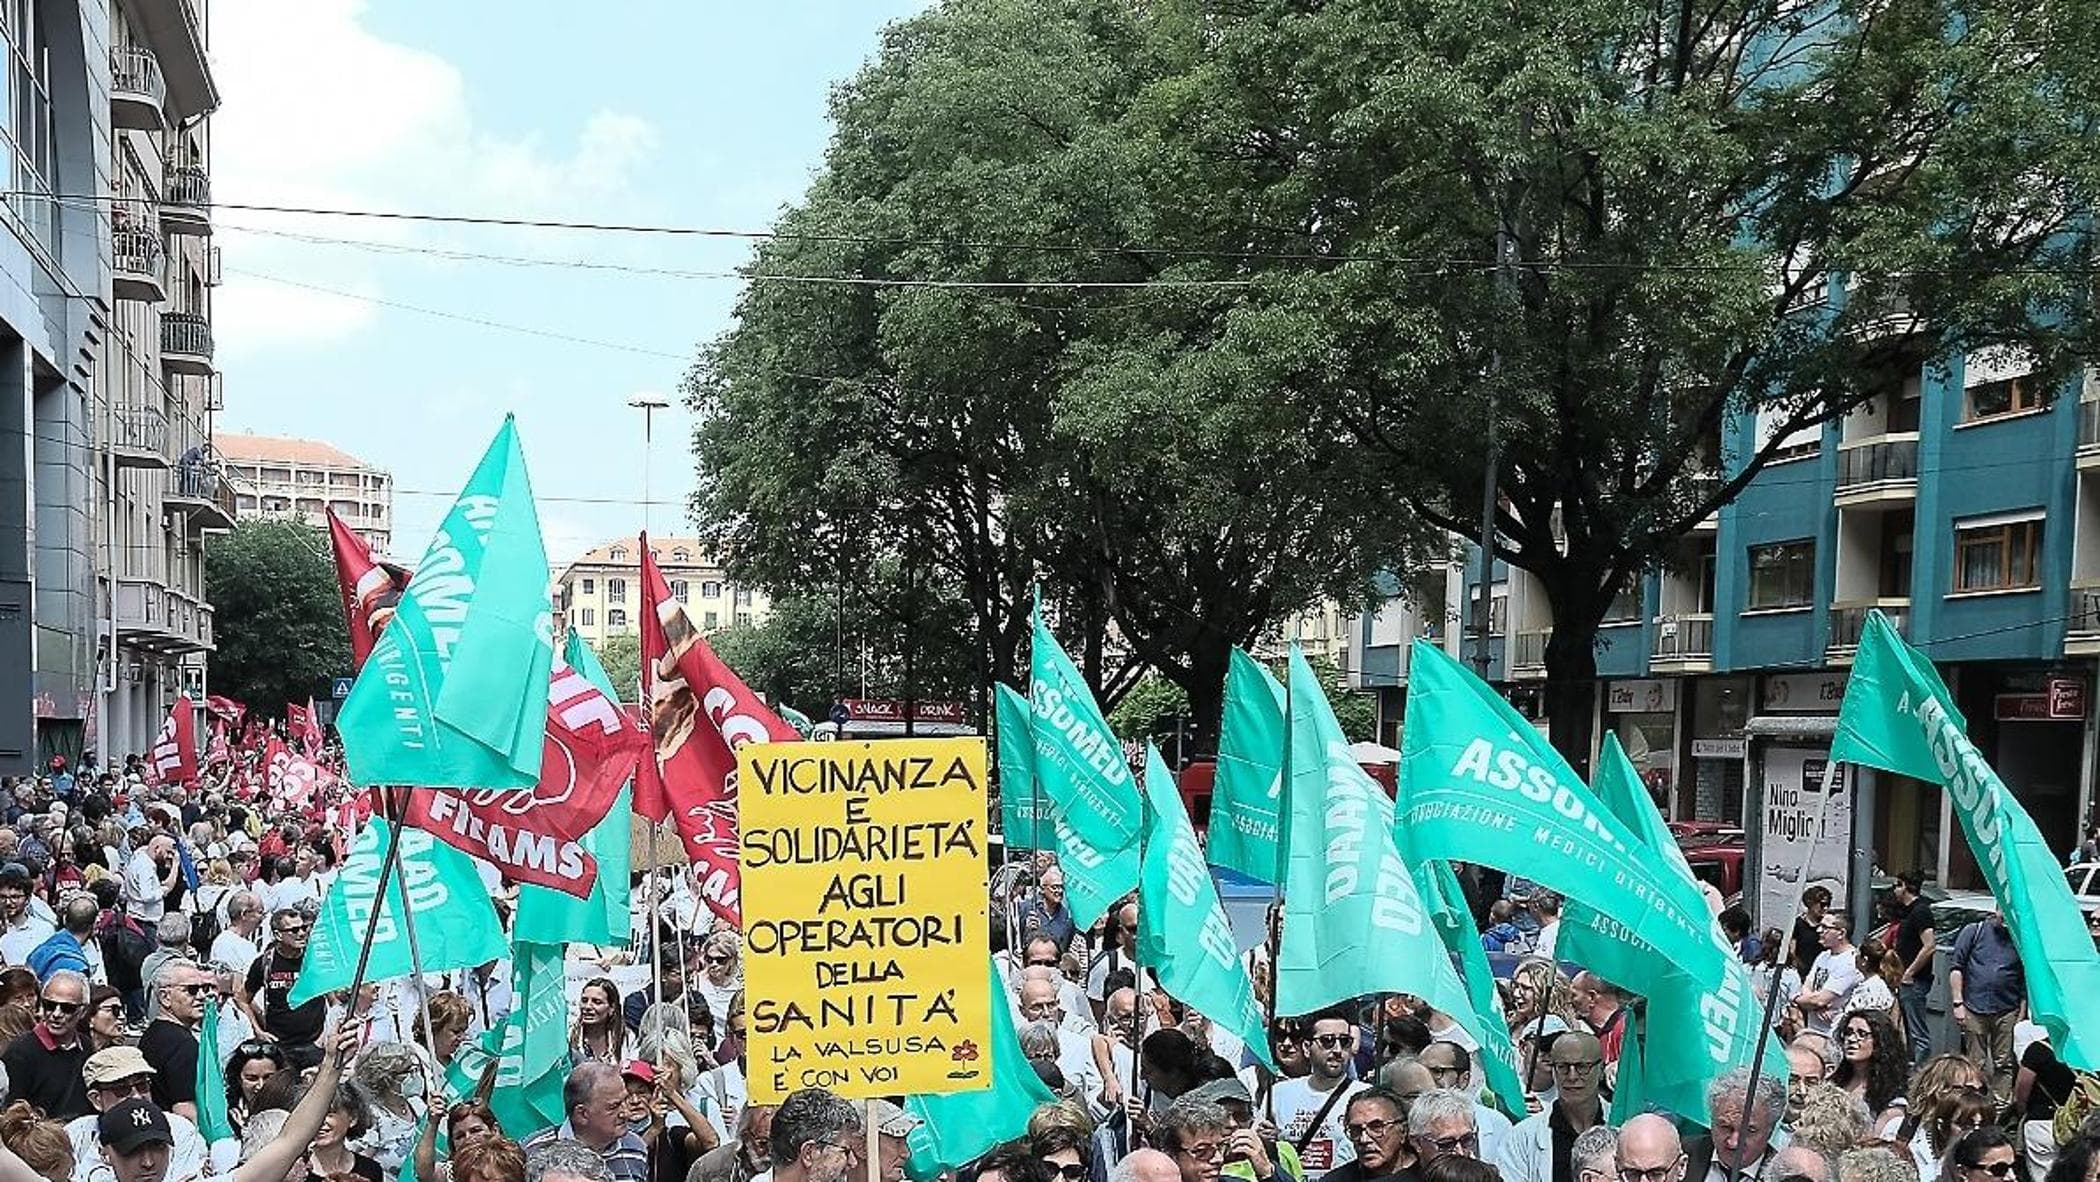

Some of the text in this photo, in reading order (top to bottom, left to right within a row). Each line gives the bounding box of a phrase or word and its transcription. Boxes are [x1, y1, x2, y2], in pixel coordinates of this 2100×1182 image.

[751, 756, 978, 795] VICINANZA
[1769, 783, 1799, 808] Nino
[1768, 809, 1826, 843] Miglioi
[1532, 825, 1607, 874] MEDICI
[817, 873, 906, 914] AGLI
[747, 915, 963, 957] OPERATORI
[815, 959, 905, 989] DELLA
[770, 1035, 947, 1064] LA VALSUSA
[800, 1068, 850, 1089] CON
[860, 1066, 899, 1084] VOI
